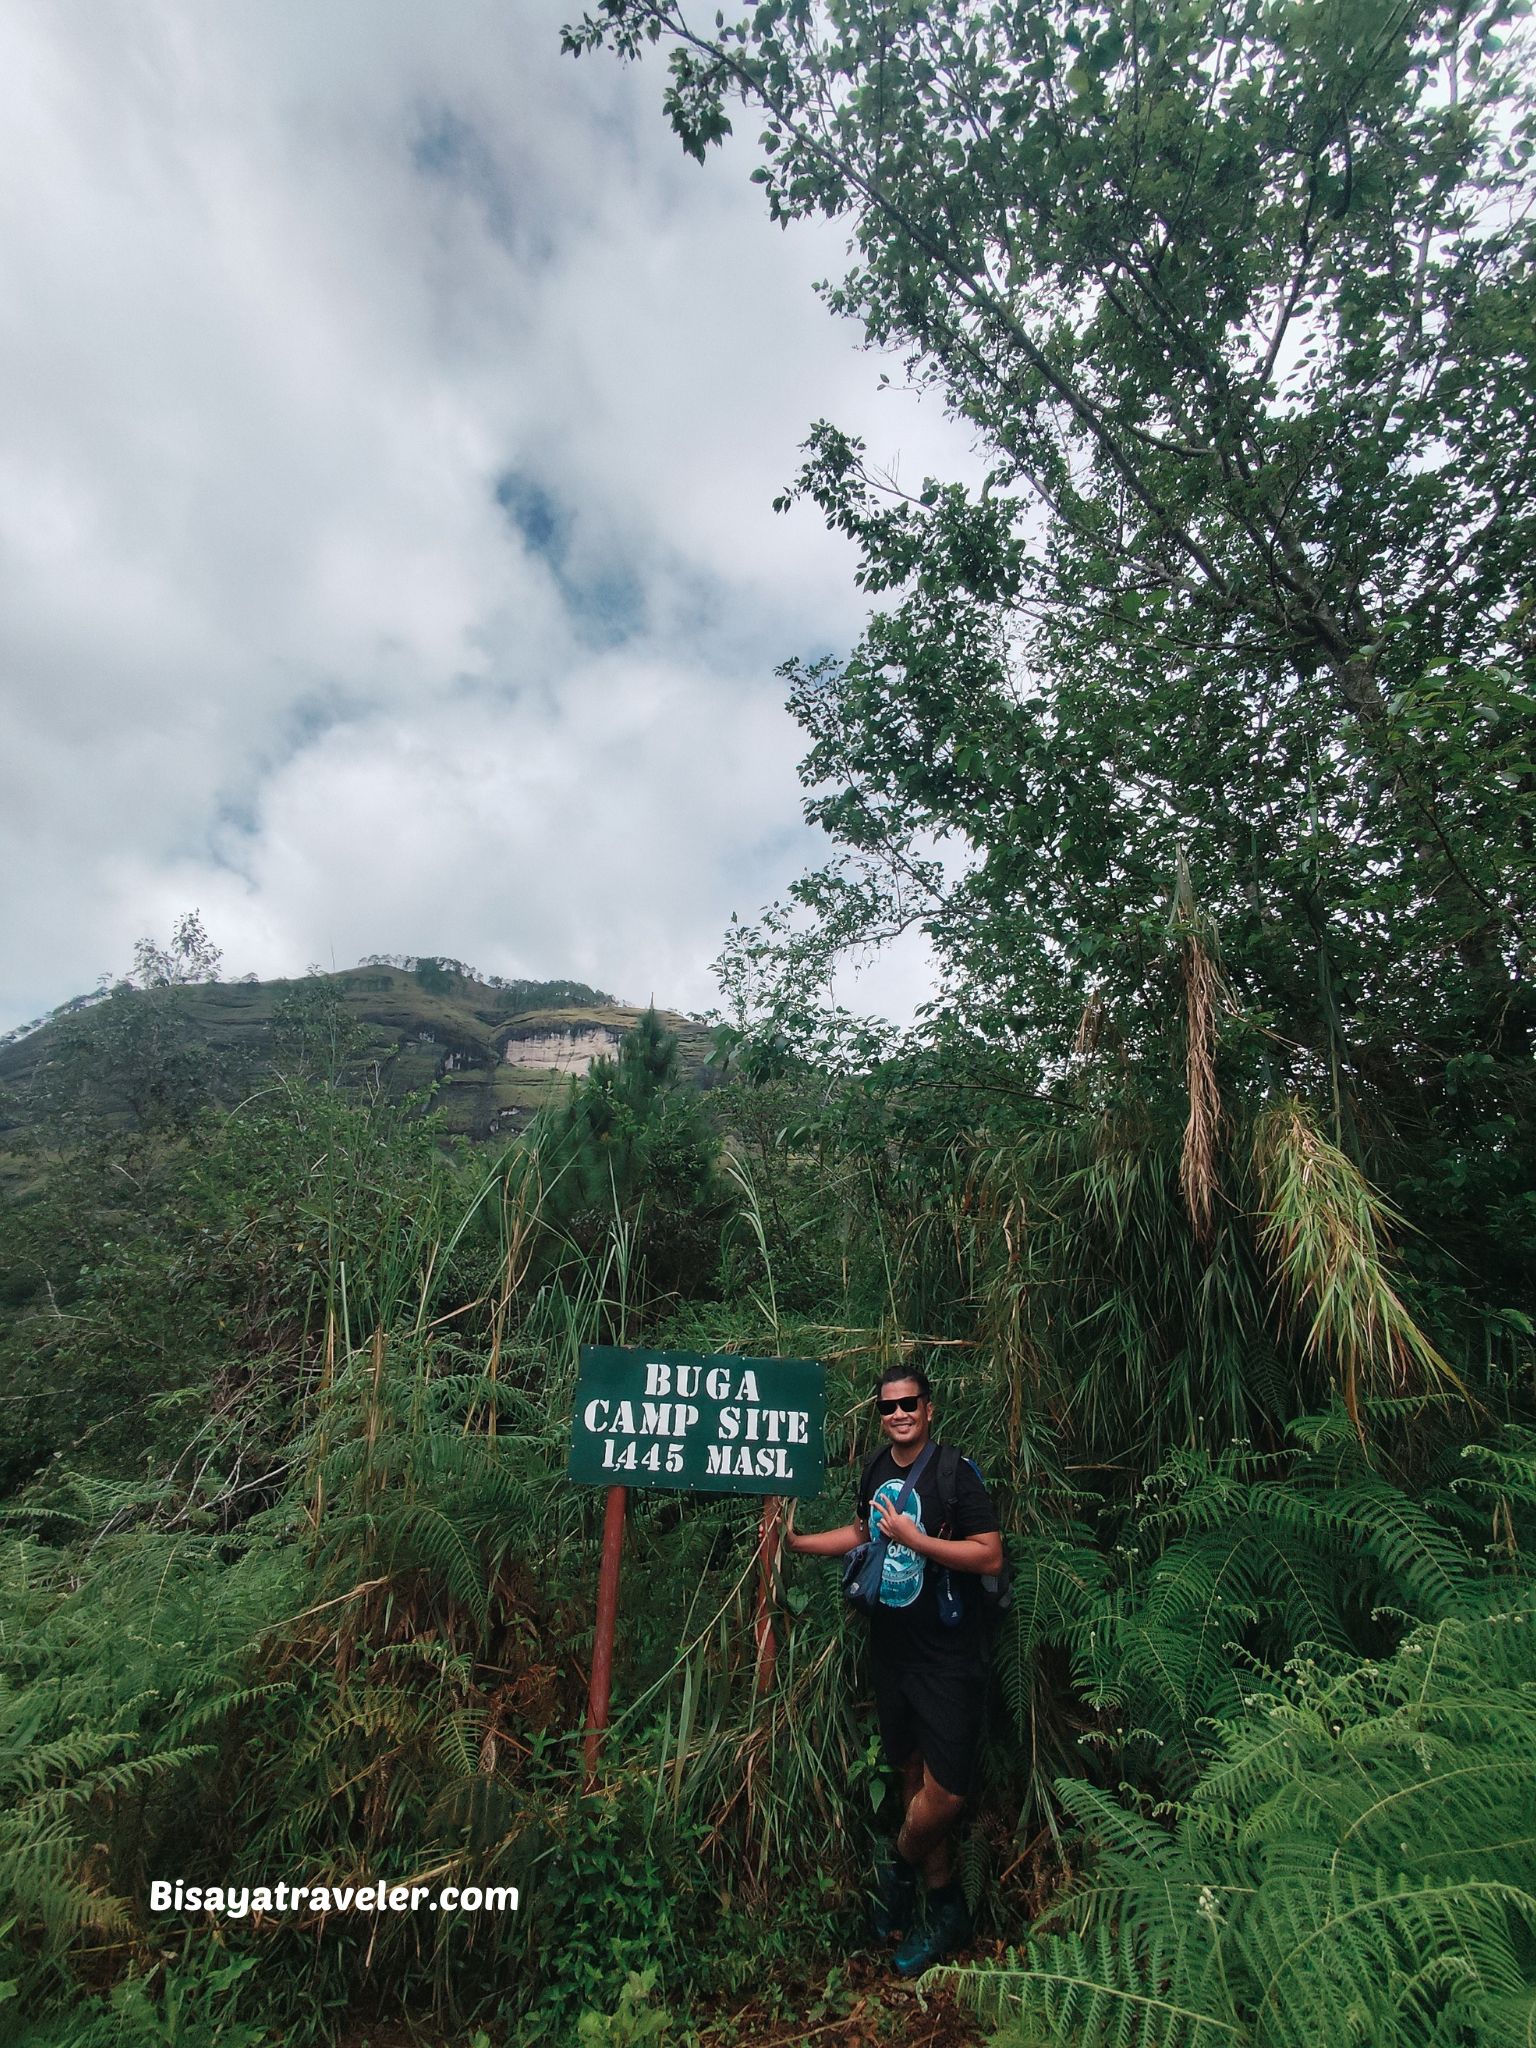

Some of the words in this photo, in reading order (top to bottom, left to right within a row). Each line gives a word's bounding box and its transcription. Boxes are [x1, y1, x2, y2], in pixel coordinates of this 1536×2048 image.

[644, 1363, 760, 1401] BUGA
[584, 1399, 699, 1437] CAMP
[718, 1406, 809, 1444] SITE
[601, 1439, 684, 1473] 1,445
[705, 1445, 793, 1478] MASL
